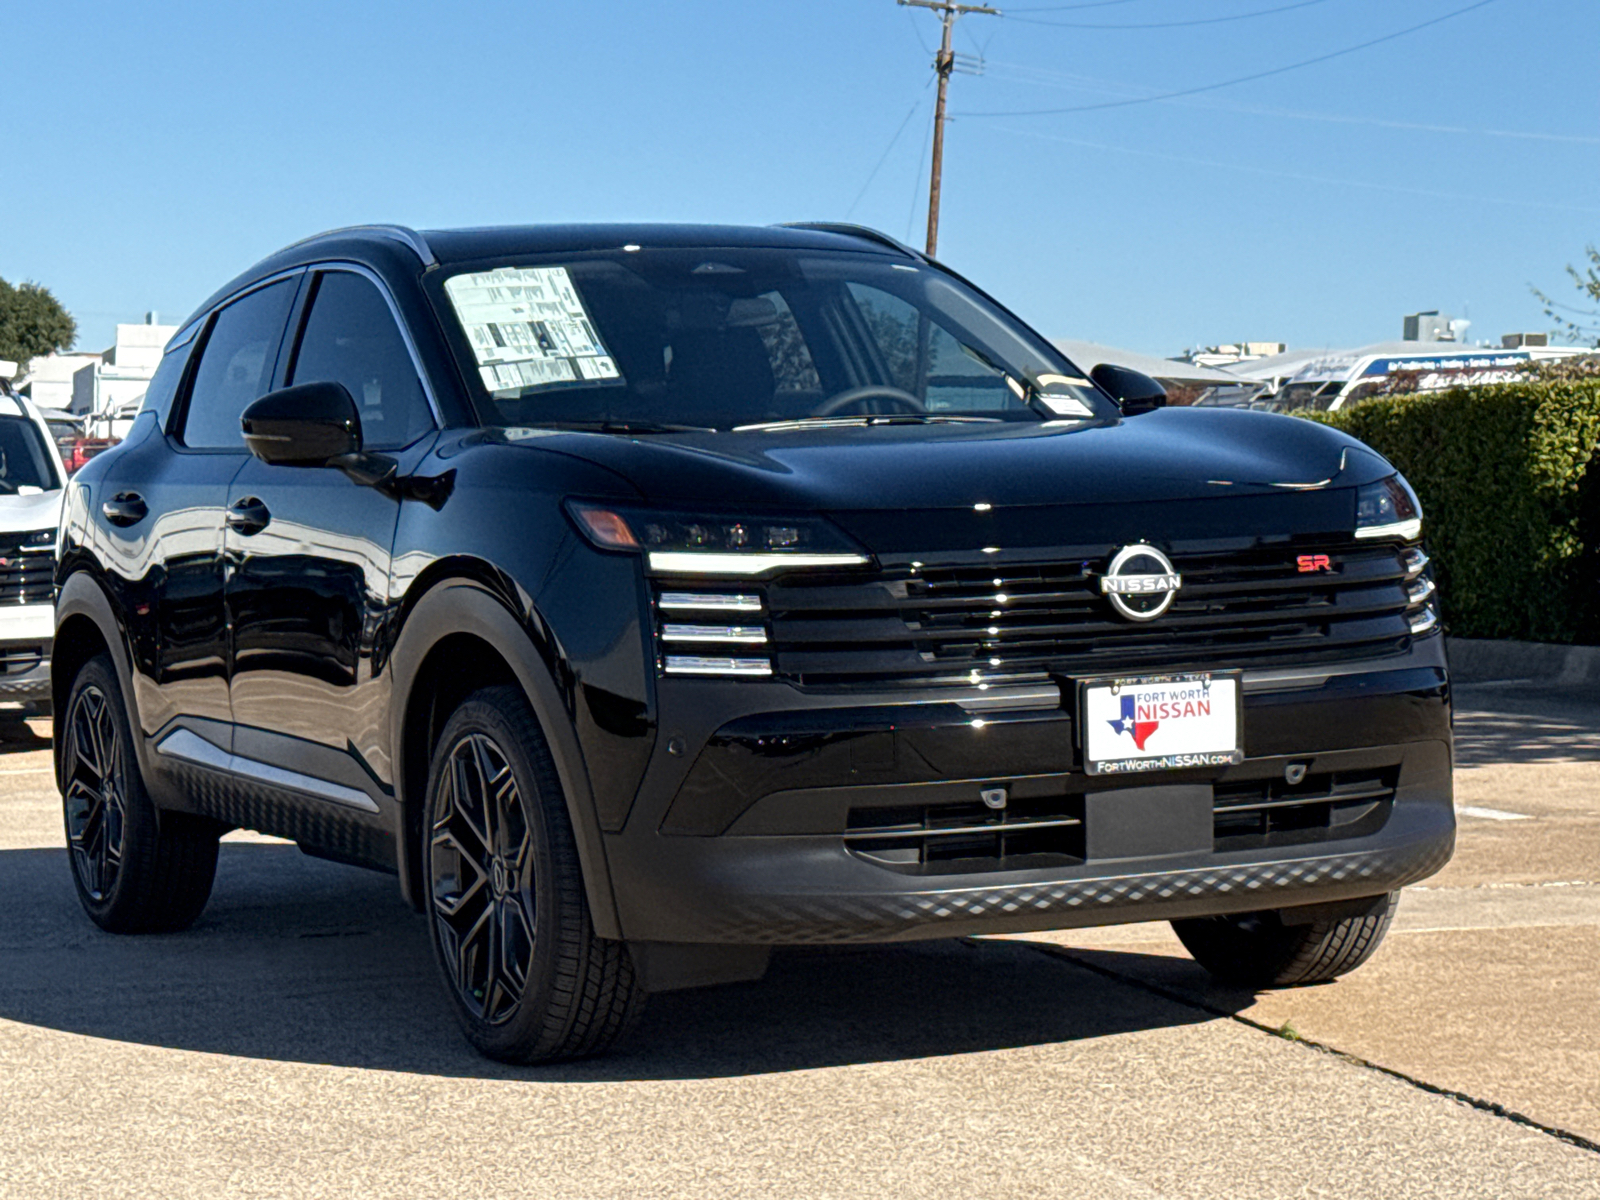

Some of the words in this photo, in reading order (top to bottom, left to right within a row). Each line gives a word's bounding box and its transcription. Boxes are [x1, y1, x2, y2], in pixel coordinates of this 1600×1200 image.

[1297, 555, 1331, 572] SR
[1102, 576, 1181, 592] NISSAN
[1114, 677, 1137, 686] FORT
[1140, 674, 1172, 684] WORTH
[1137, 692, 1166, 702] FORT
[1169, 689, 1210, 701] WORTH
[1137, 700, 1211, 720] NISSAN
